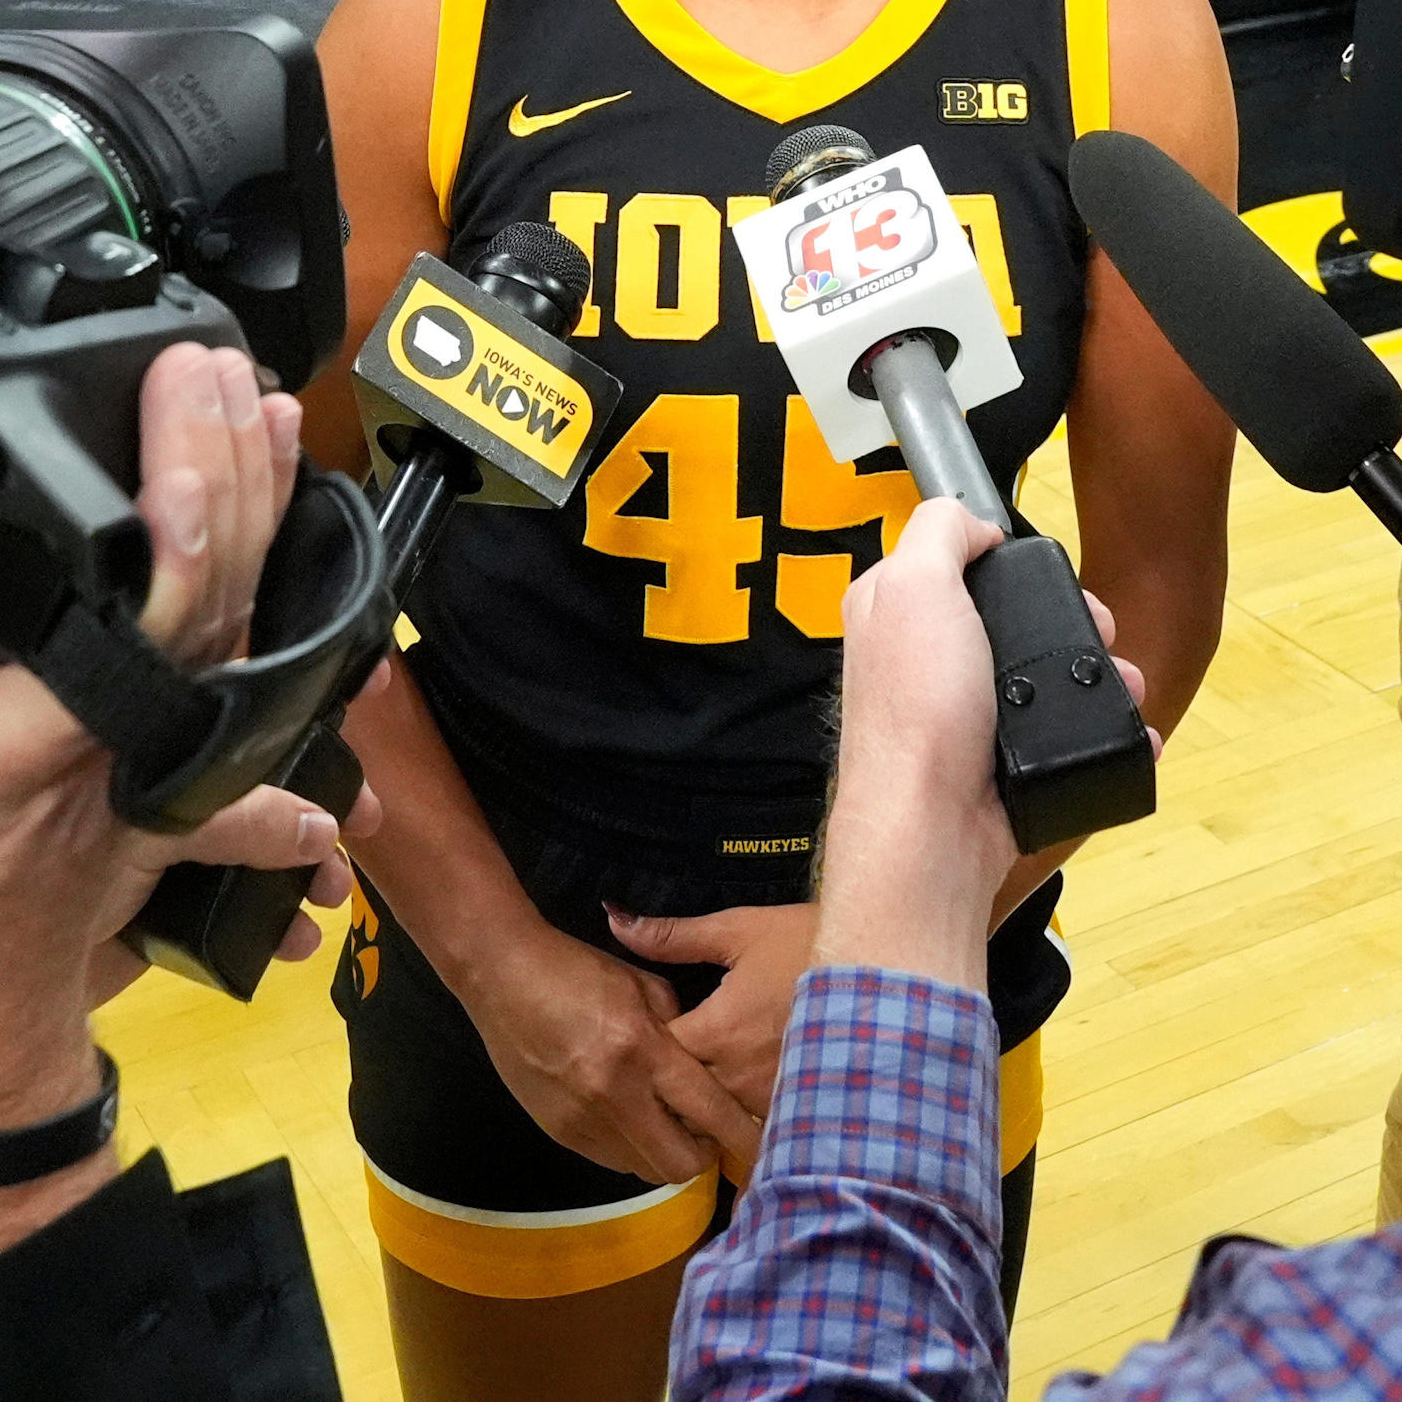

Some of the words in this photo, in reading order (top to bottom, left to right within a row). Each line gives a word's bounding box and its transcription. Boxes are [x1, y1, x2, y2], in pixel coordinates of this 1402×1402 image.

[815, 174, 887, 214] WHO
[801, 189, 919, 280] 13
[821, 293, 852, 316] DES
[855, 265, 915, 298] MOINES
[465, 364, 571, 446] NOW
[483, 348, 534, 387] IOWA'S
[534, 382, 578, 416] NEWS
[583, 394, 928, 644] 45
[721, 837, 811, 854] HAWKEYES
